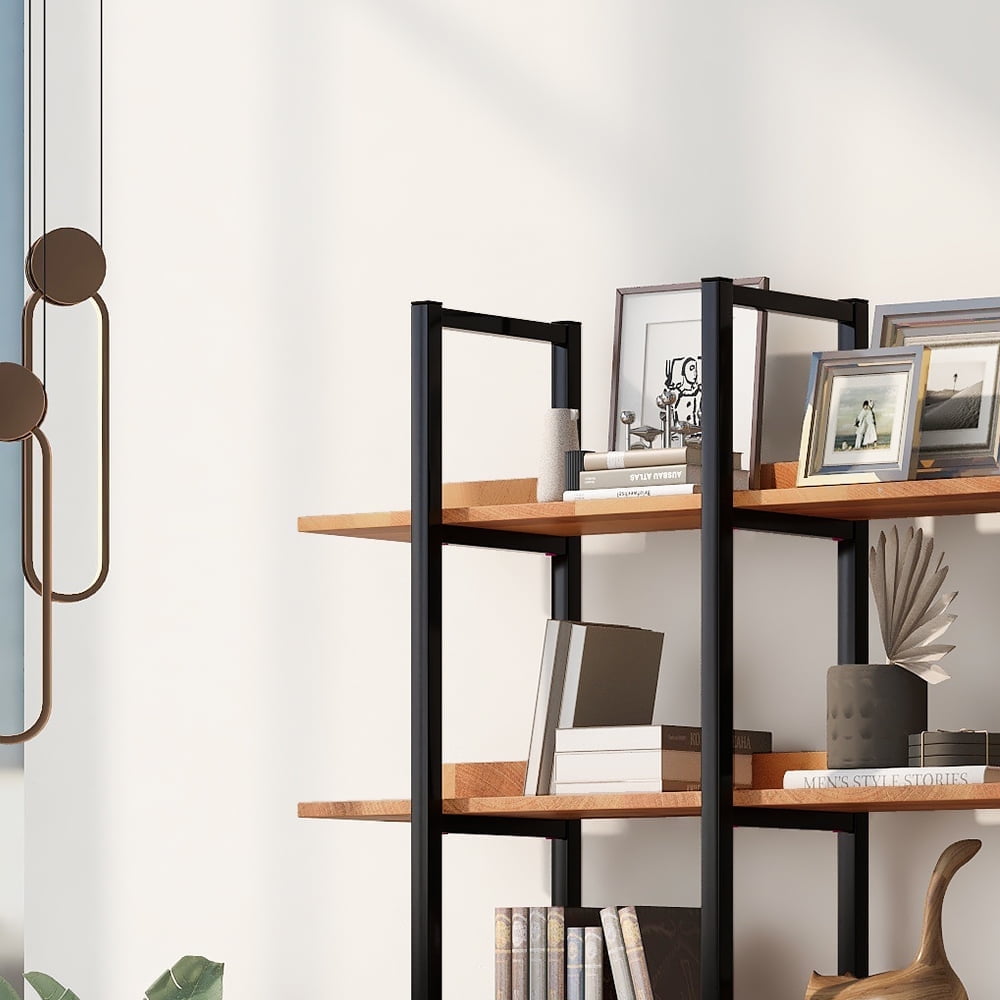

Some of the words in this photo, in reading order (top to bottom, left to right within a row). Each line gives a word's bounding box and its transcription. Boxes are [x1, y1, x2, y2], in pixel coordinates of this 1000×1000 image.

[629, 473, 652, 482] ATLAS
[653, 471, 682, 480] AUSBAU
[803, 776, 849, 788] MEN'S
[853, 774, 899, 787] STYLE
[903, 772, 968, 786] STORIES
